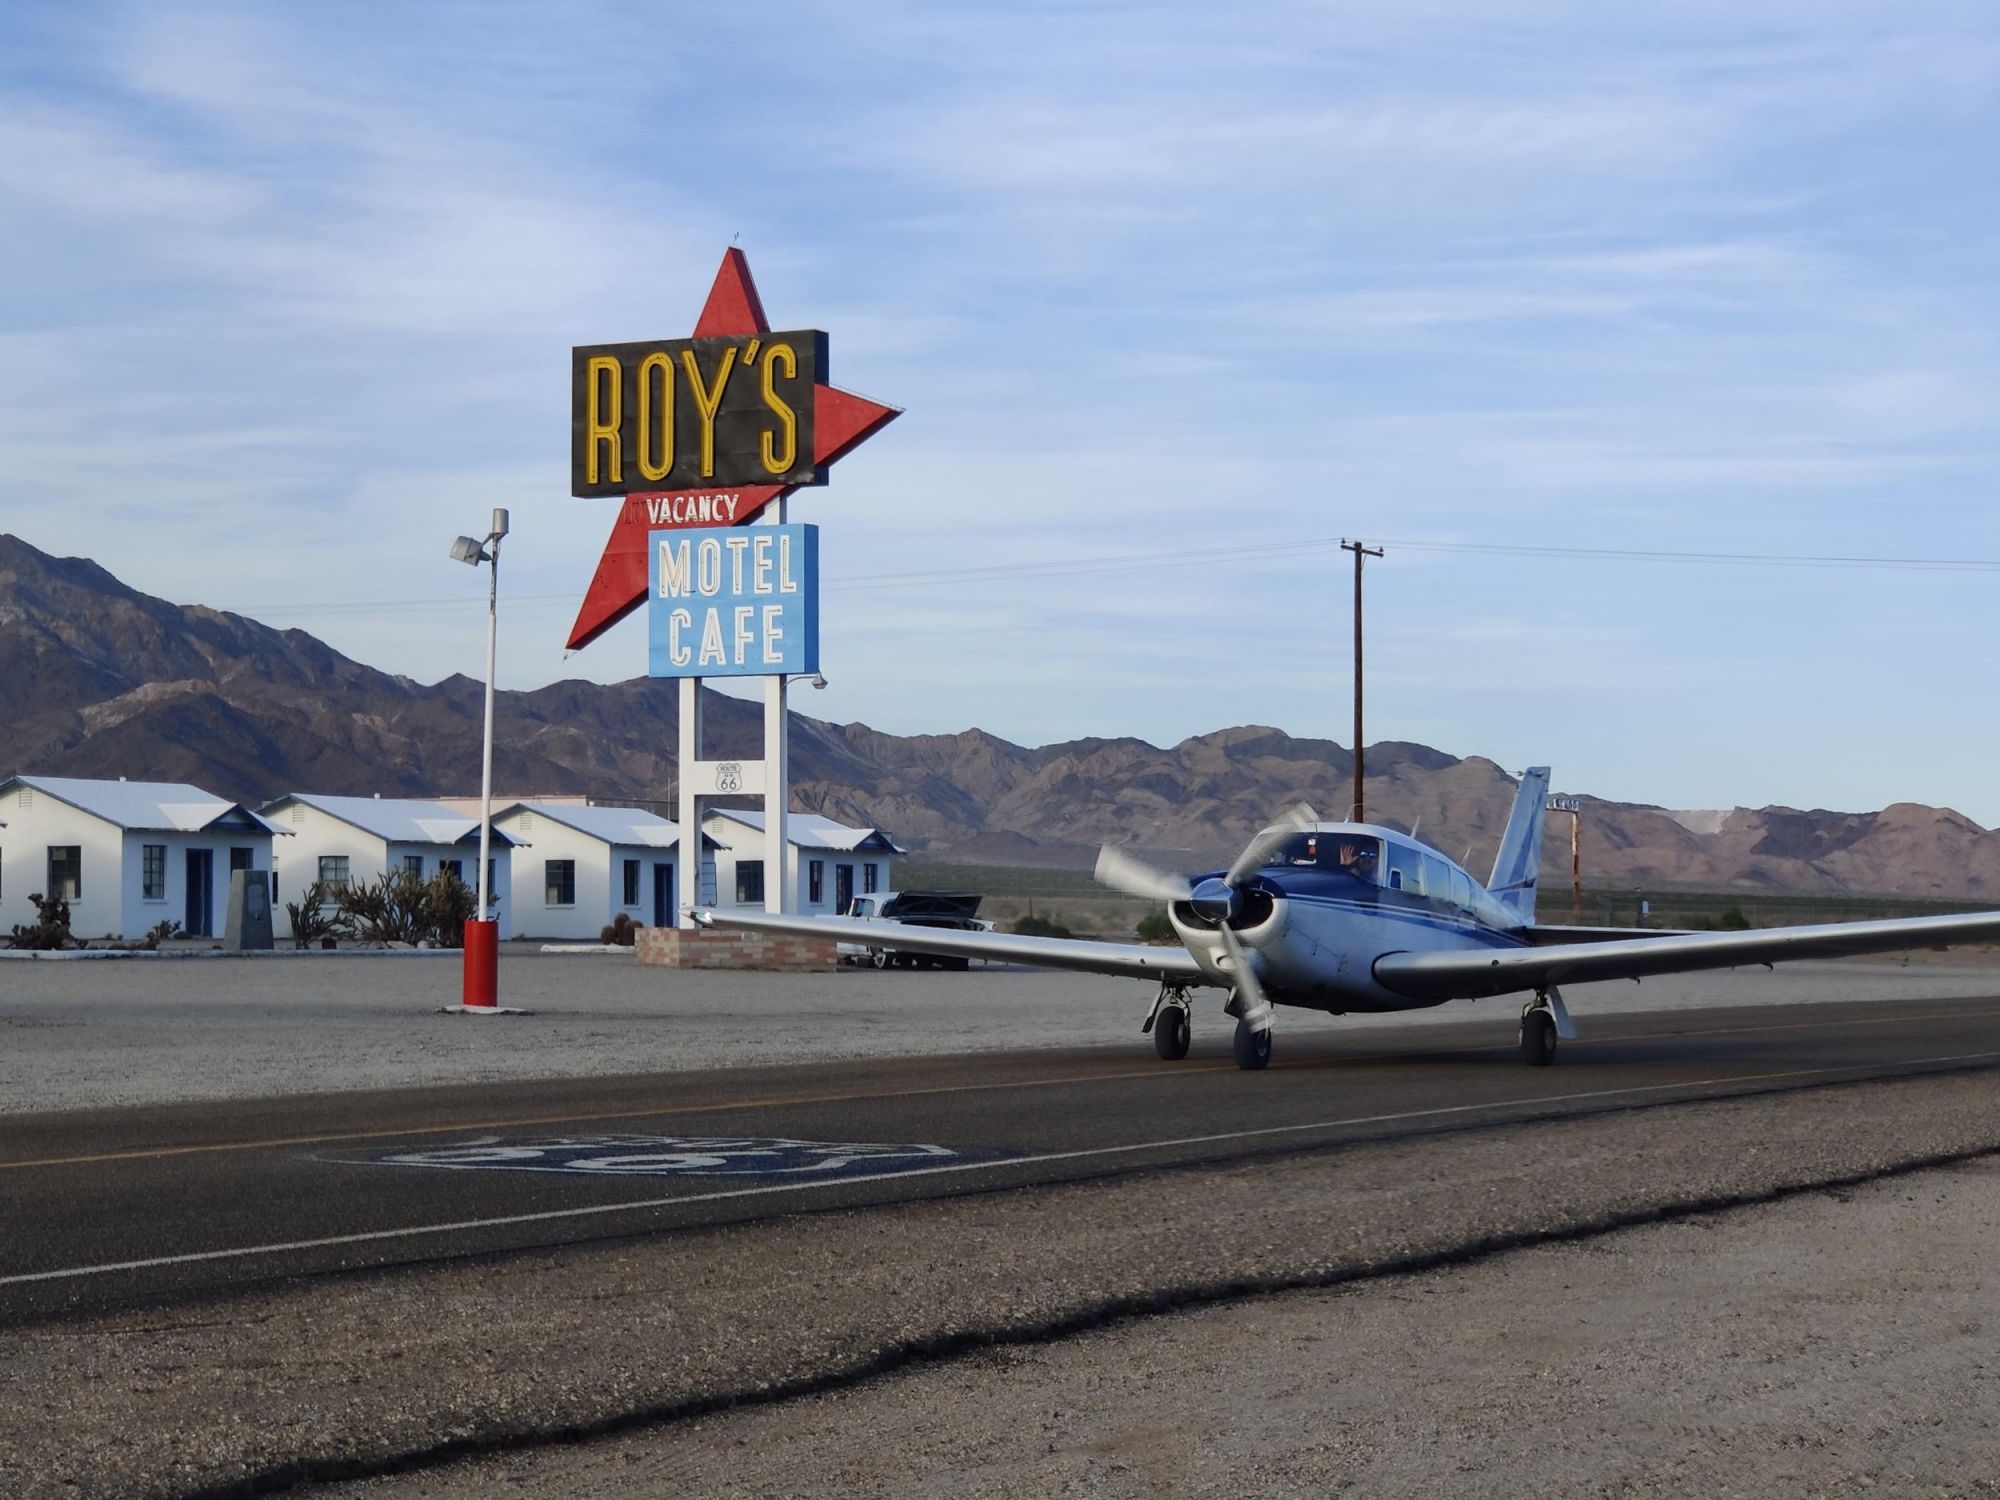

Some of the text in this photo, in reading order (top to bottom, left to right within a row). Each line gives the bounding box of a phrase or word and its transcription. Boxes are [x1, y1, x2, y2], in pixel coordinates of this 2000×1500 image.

[585, 338, 798, 485] ROY'S
[646, 494, 739, 524] VACANCY
[658, 534, 797, 598] MOTEL
[669, 604, 784, 667] CAFE
[721, 778, 737, 790] 66
[382, 1144, 782, 1170] 66
